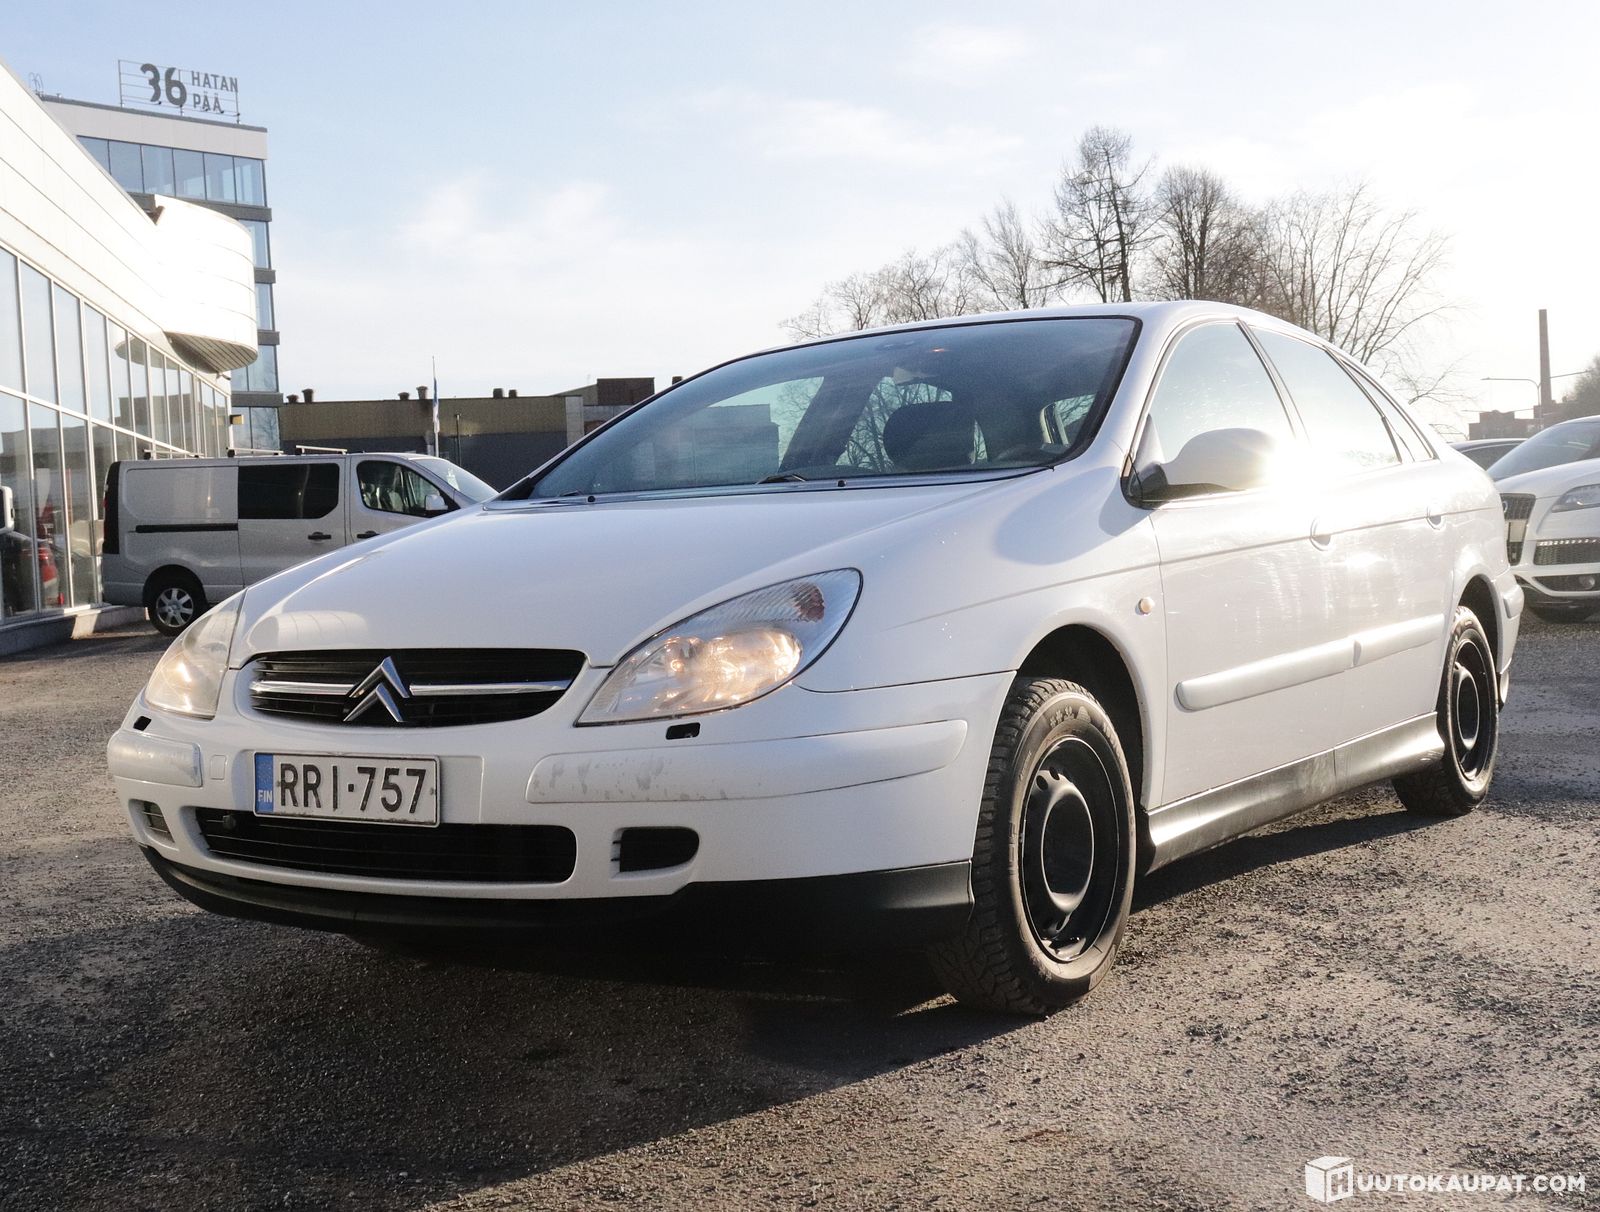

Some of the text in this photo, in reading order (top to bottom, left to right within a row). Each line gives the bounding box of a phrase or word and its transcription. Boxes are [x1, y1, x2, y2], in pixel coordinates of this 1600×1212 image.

[140, 63, 187, 106] 36
[191, 70, 239, 93] HATAN
[193, 91, 223, 112] PÄÄ
[258, 789, 273, 803] FIN
